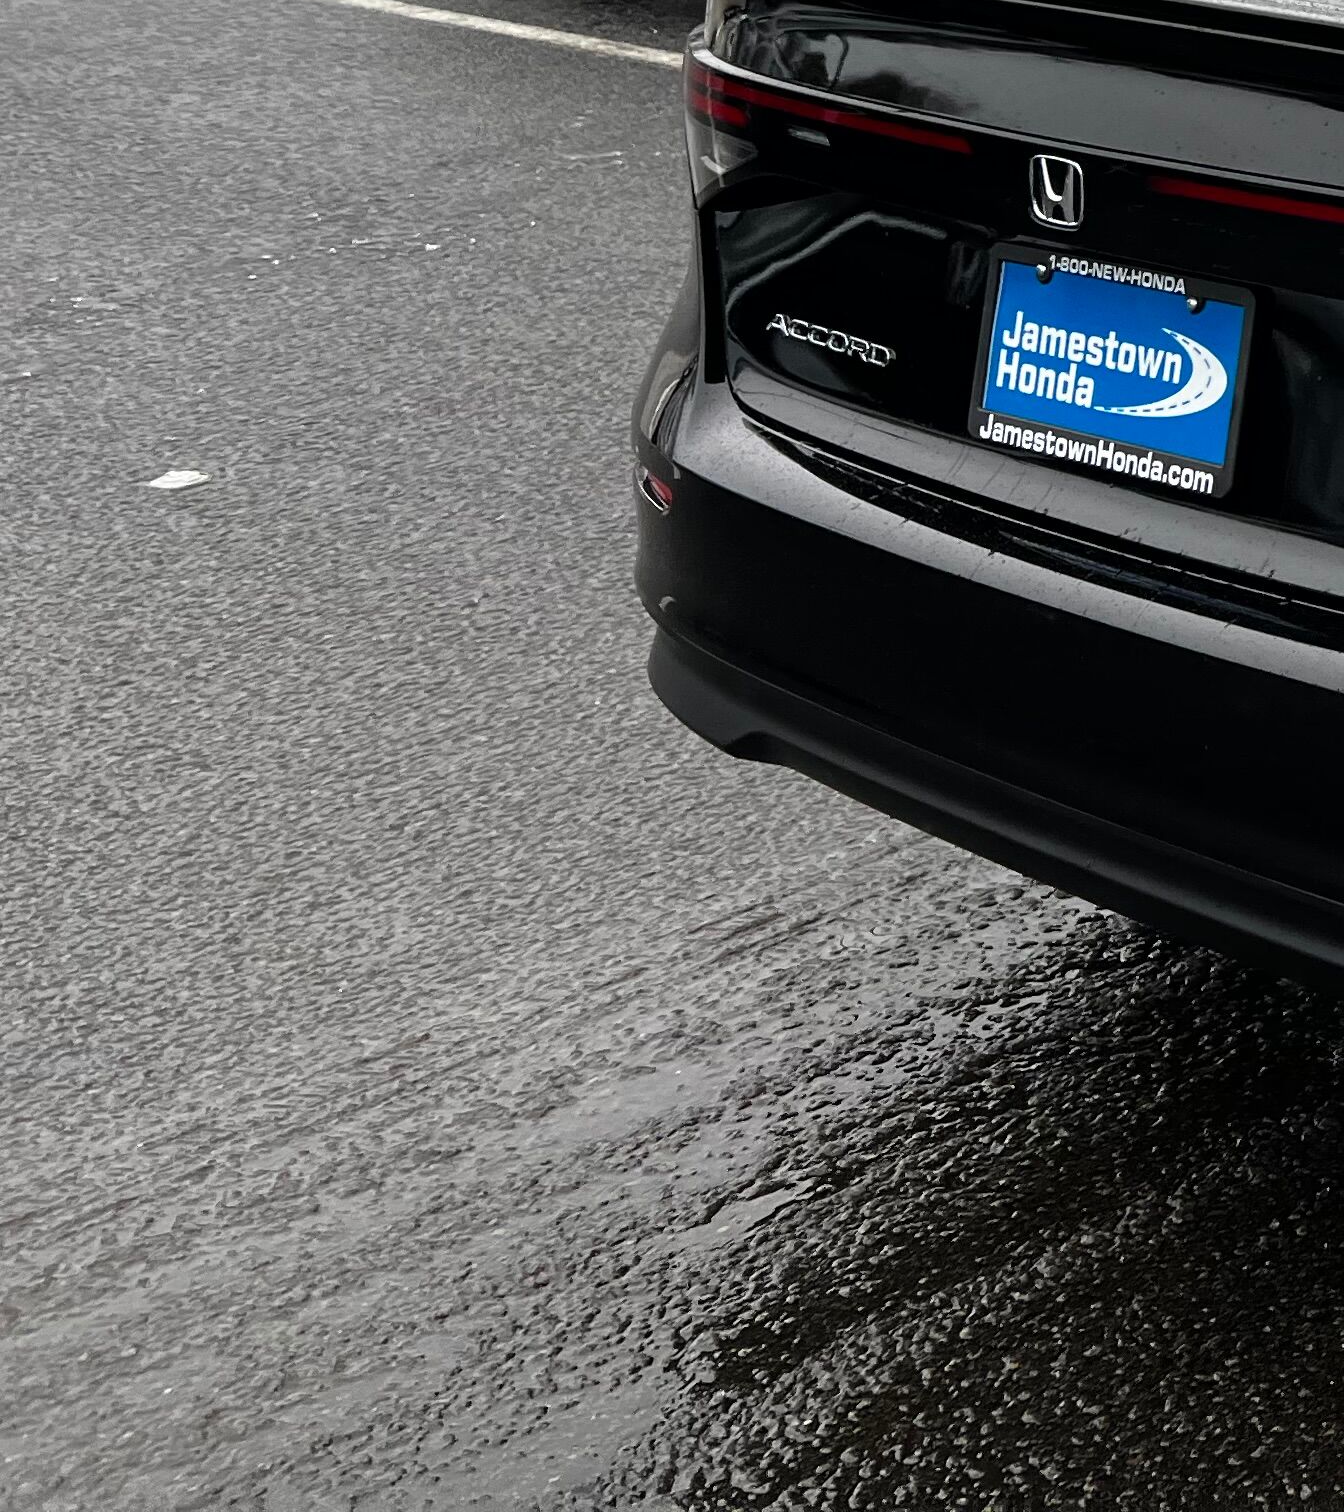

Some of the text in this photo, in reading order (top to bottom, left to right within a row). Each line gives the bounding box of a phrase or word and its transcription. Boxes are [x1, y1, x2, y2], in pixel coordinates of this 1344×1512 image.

[1049, 254, 1186, 295] 1-800-NEW-HONDA
[766, 313, 896, 368] ACCORD
[1002, 310, 1183, 384] Jamestown
[996, 348, 1095, 409] Honda
[979, 413, 1215, 494] JamestownHonda.com
